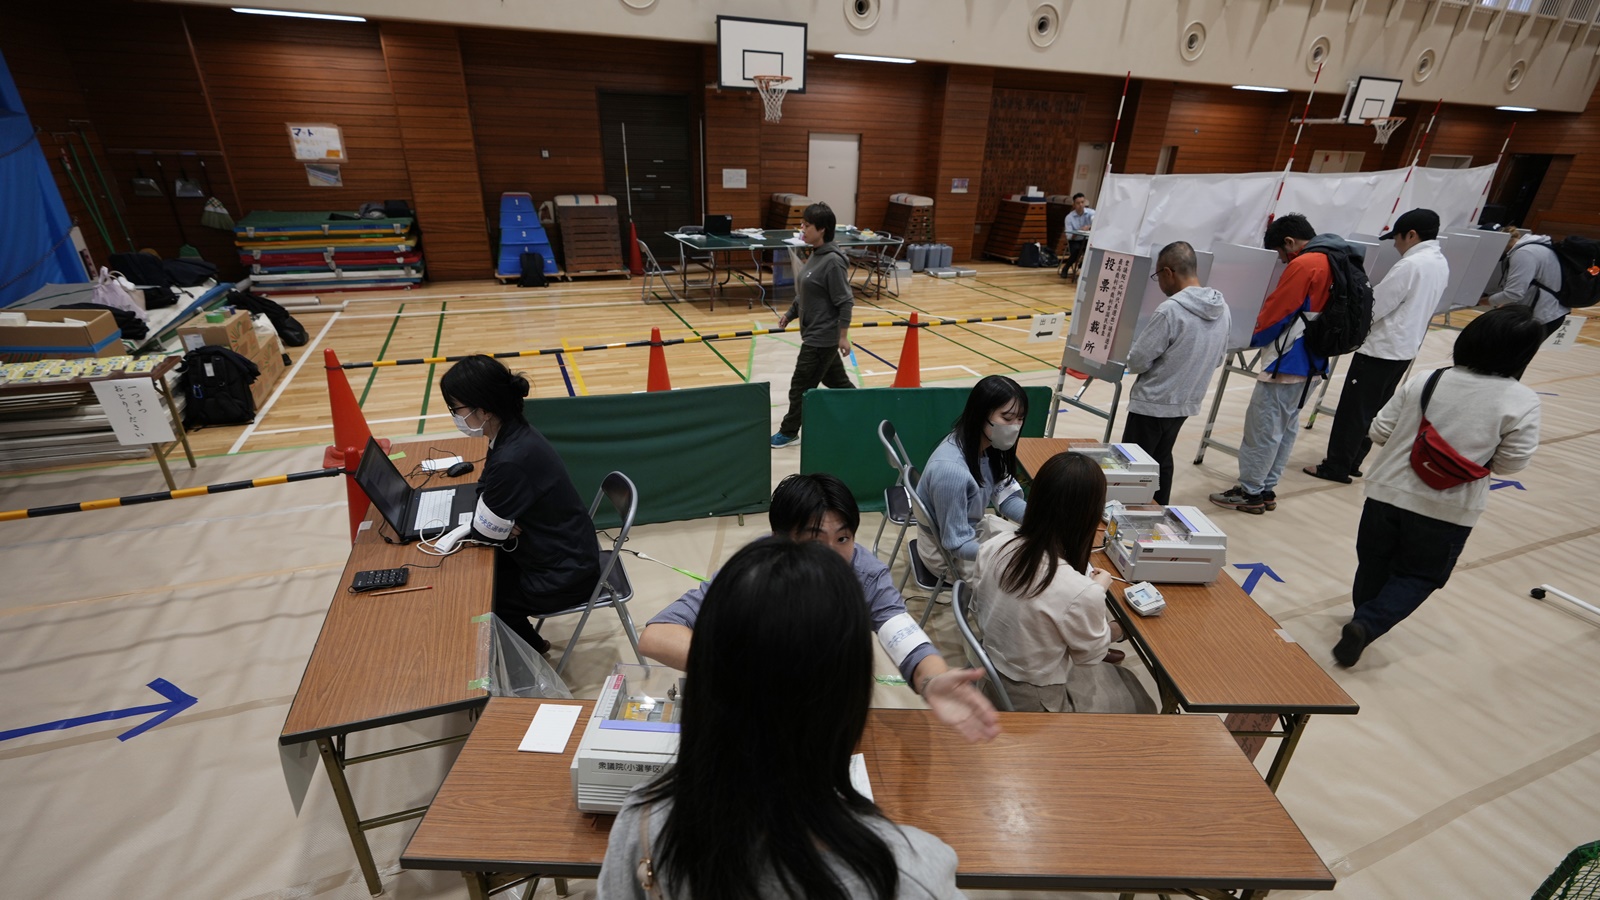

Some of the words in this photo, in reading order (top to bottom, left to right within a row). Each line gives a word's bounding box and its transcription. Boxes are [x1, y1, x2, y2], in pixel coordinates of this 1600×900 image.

[1040, 317, 1057, 326] 出口
[1083, 256, 1116, 354] 投票記載所
[1552, 319, 1571, 345] 進入禁止
[114, 385, 145, 438] おとりください
